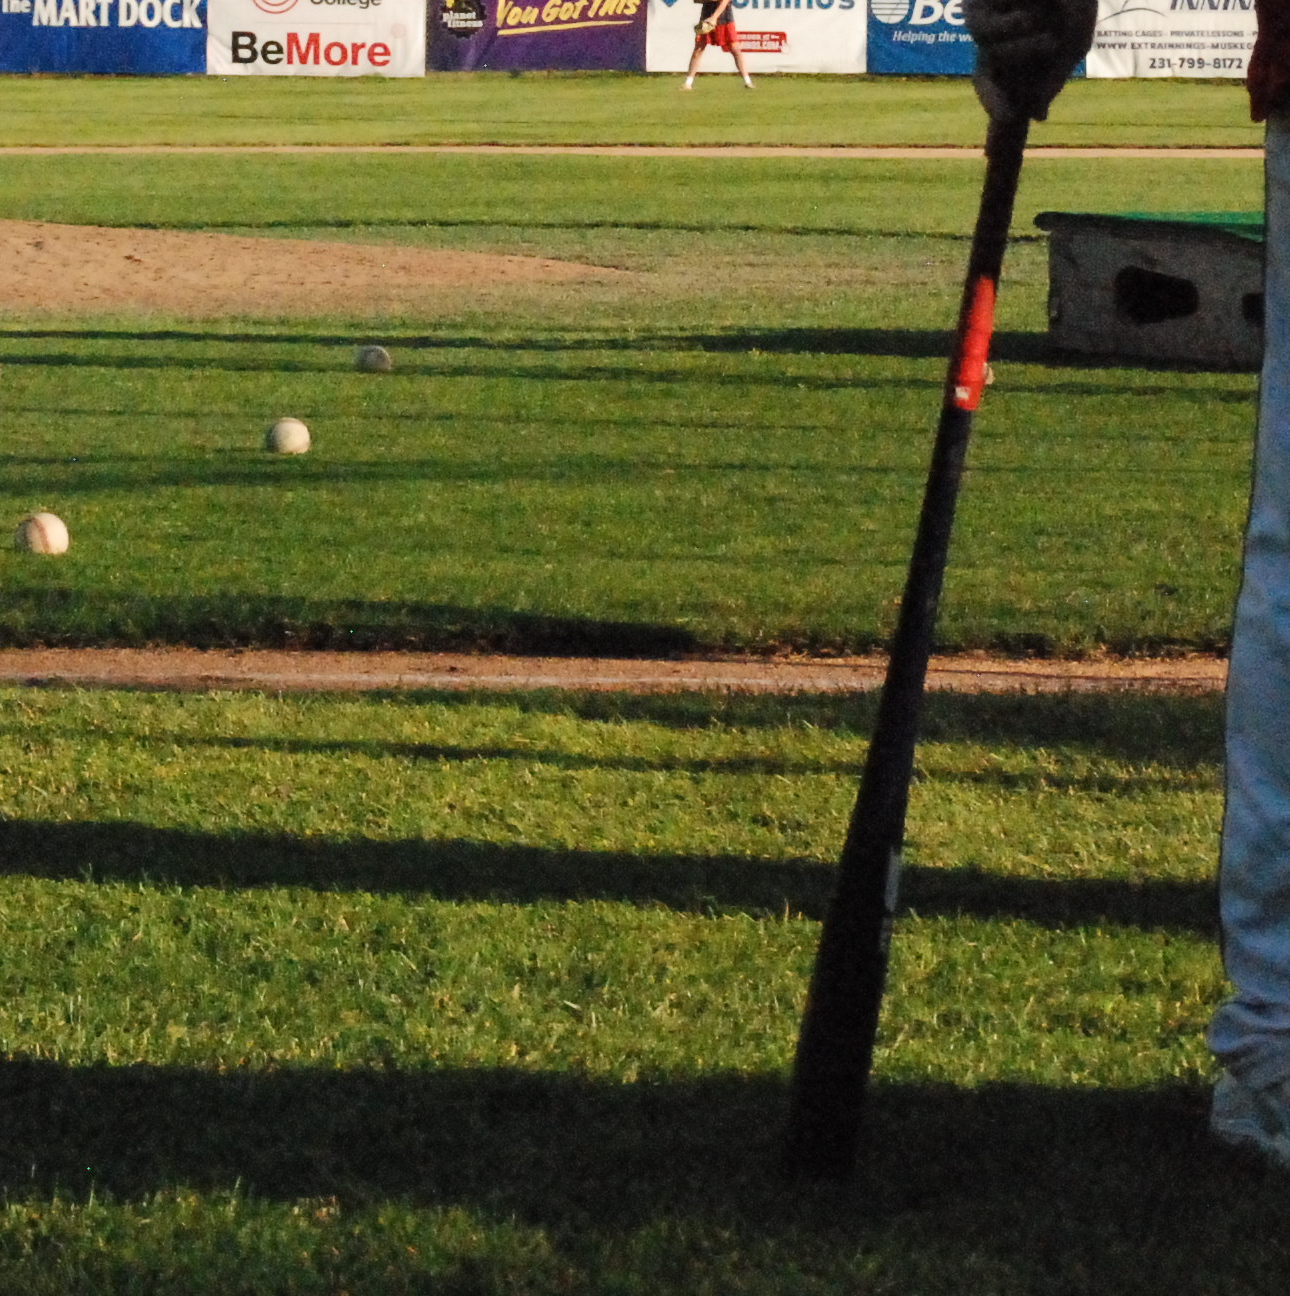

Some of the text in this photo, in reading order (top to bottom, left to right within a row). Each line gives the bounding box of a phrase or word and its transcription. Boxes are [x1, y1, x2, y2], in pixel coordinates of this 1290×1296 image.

[442, 10, 477, 22] planet
[892, 30, 936, 44] Helping
[938, 30, 955, 42] the
[231, 30, 392, 67] BeMore
[1148, 57, 1244, 69] 231-799-8172
